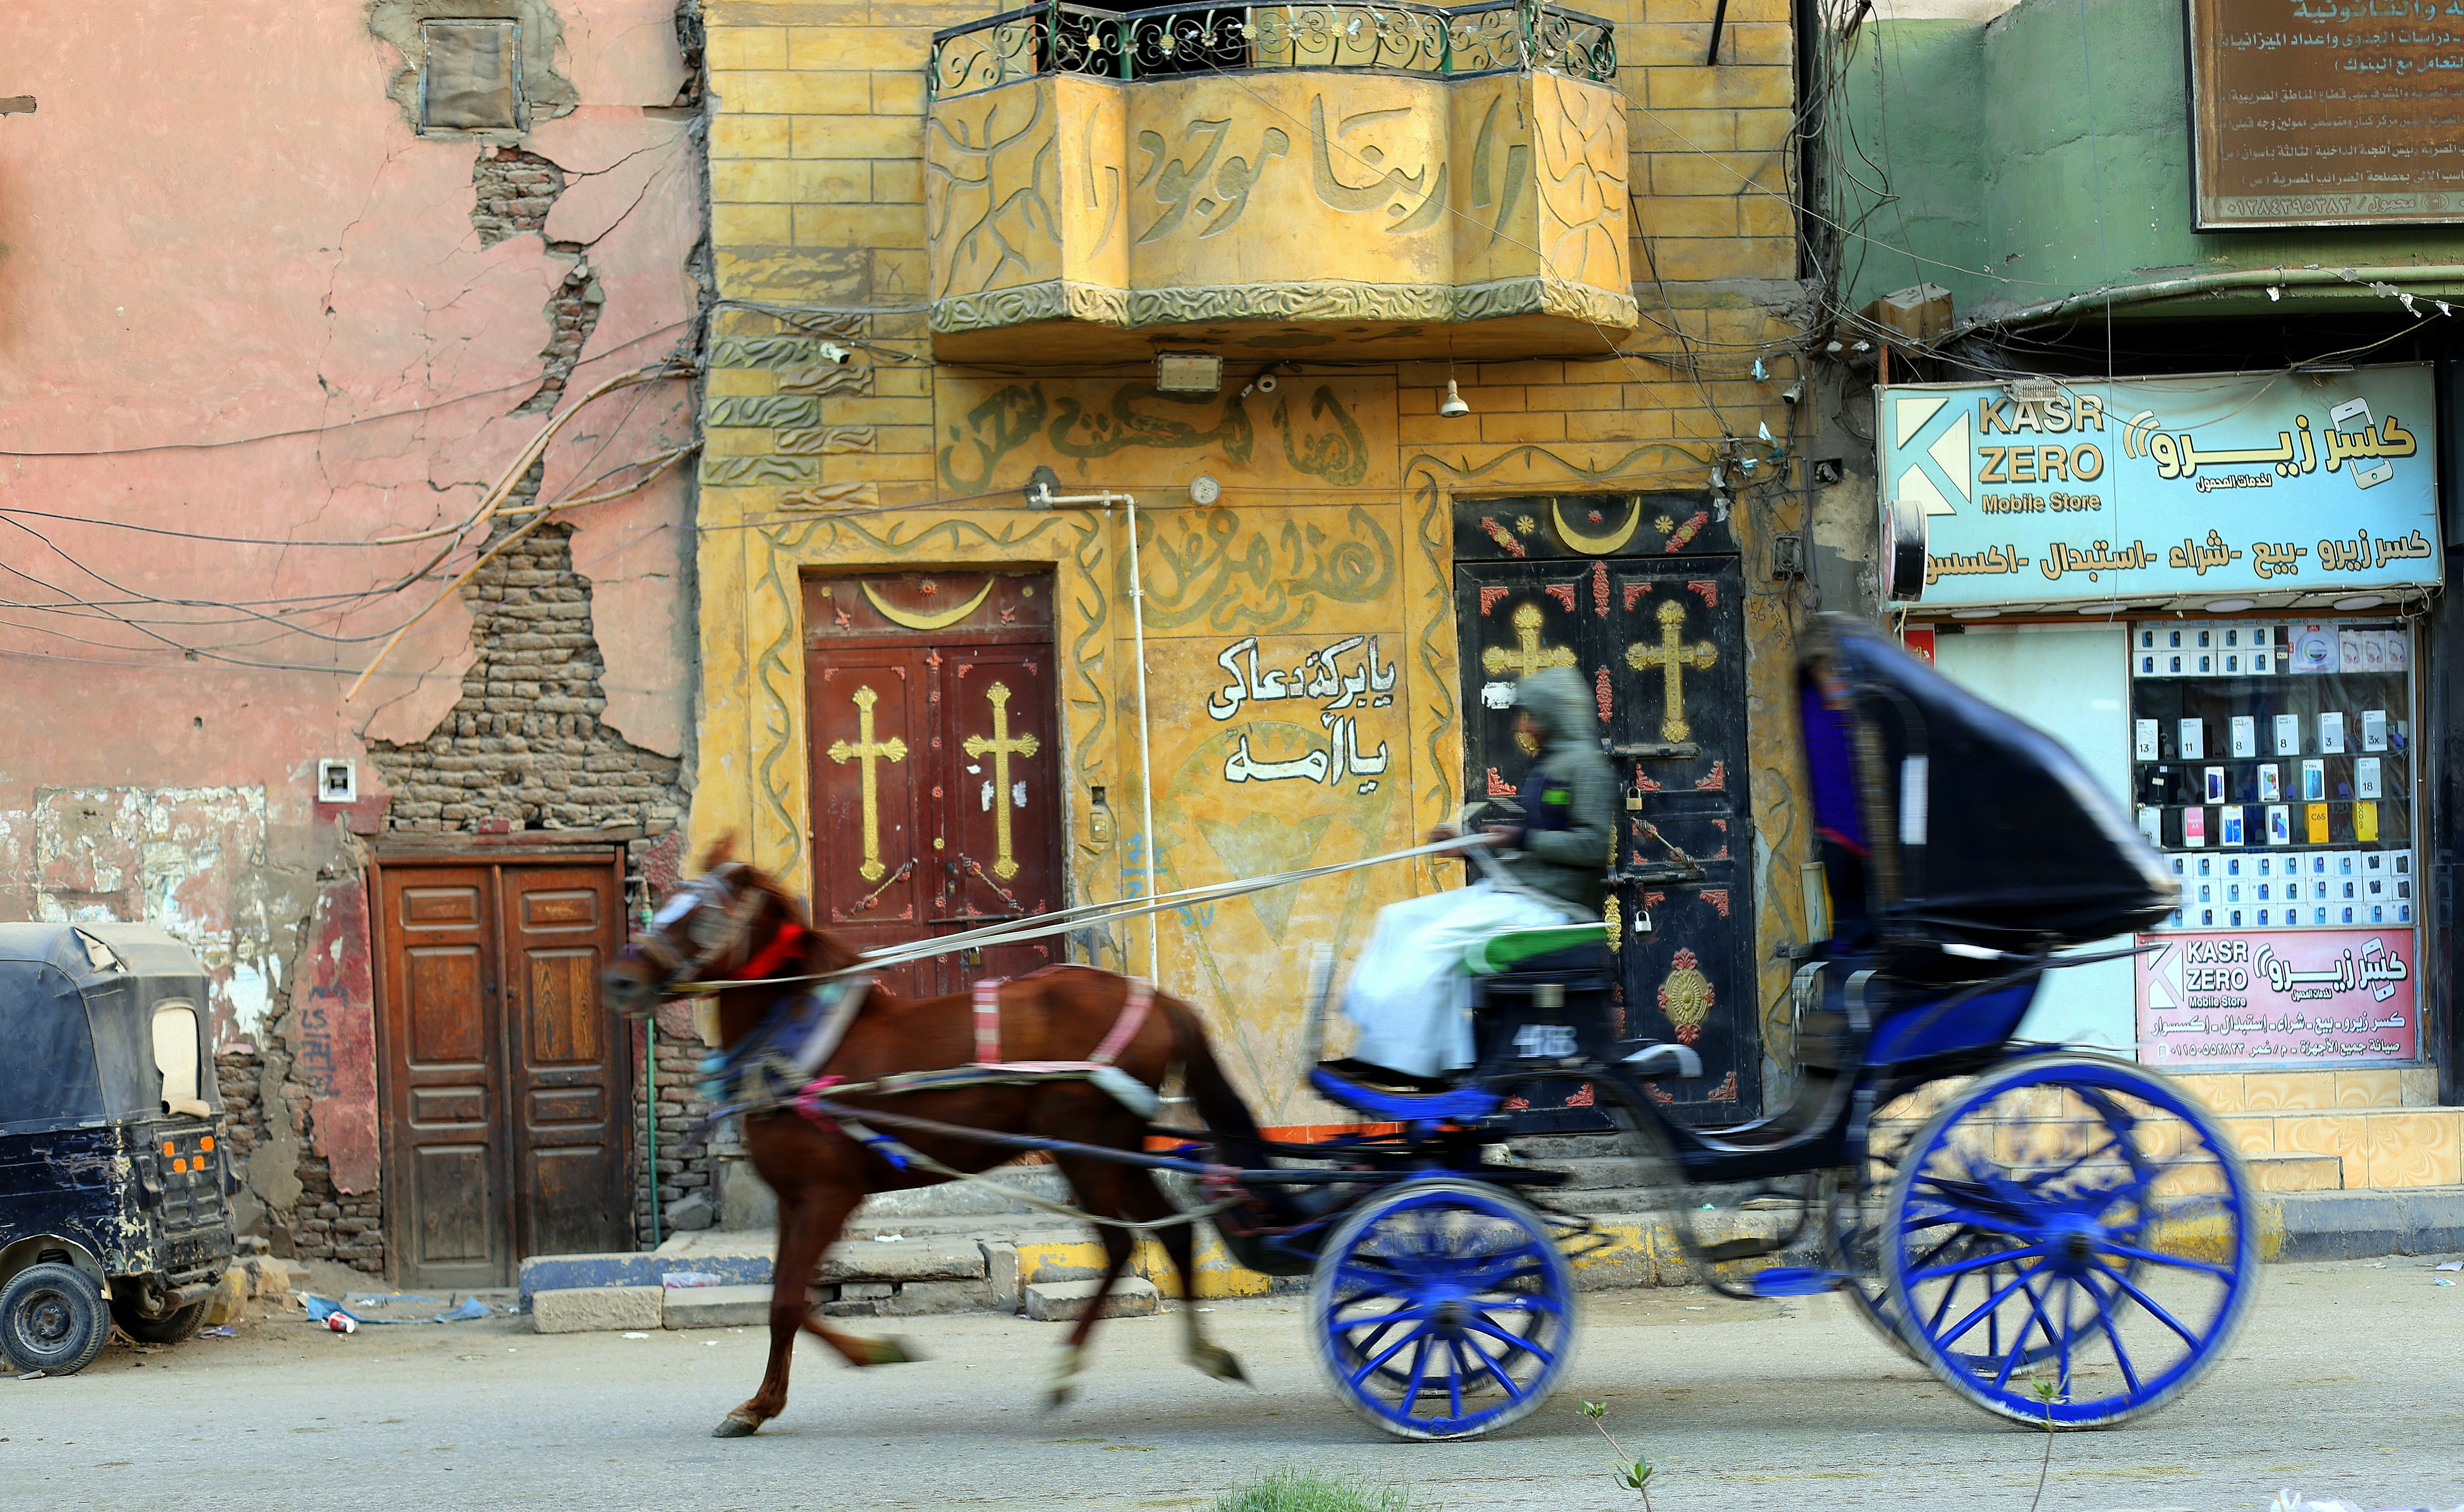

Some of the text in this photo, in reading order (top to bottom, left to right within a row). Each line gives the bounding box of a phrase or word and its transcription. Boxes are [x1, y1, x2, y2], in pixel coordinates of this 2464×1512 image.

[2342, 56, 2391, 74] البنوك
[2396, 60, 2413, 75] مع
[2417, 55, 2464, 73] لتعامل
[1978, 395, 2104, 434] KASR
[2324, 416, 2417, 472] كسر
[1978, 443, 2104, 483] ZERO
[2196, 474, 2237, 493] المحمول
[1982, 492, 2102, 513] Mobile Store
[2317, 529, 2372, 572] زيرو
[2375, 530, 2432, 568] كسر
[2139, 743, 2149, 752] 13
[2184, 743, 2193, 752] 11
[2235, 741, 2242, 750] 8
[2280, 739, 2287, 748] 8
[2325, 737, 2332, 747] 3
[2368, 735, 2379, 744] 3x
[2363, 782, 2373, 791] 18
[2187, 940, 2249, 963] KASR
[2186, 967, 2249, 992] ZERO
[2359, 951, 2408, 990] كسر
[2188, 995, 2247, 1008] Mobile Store
[2276, 1012, 2304, 1034] شراء
[2314, 1017, 2334, 1035] بيع
[2342, 1011, 2369, 1034] زيرو
[2371, 1010, 2406, 1030] كسر
[2339, 1041, 2367, 1057] جميع
[2370, 1039, 2400, 1055] صيانة
